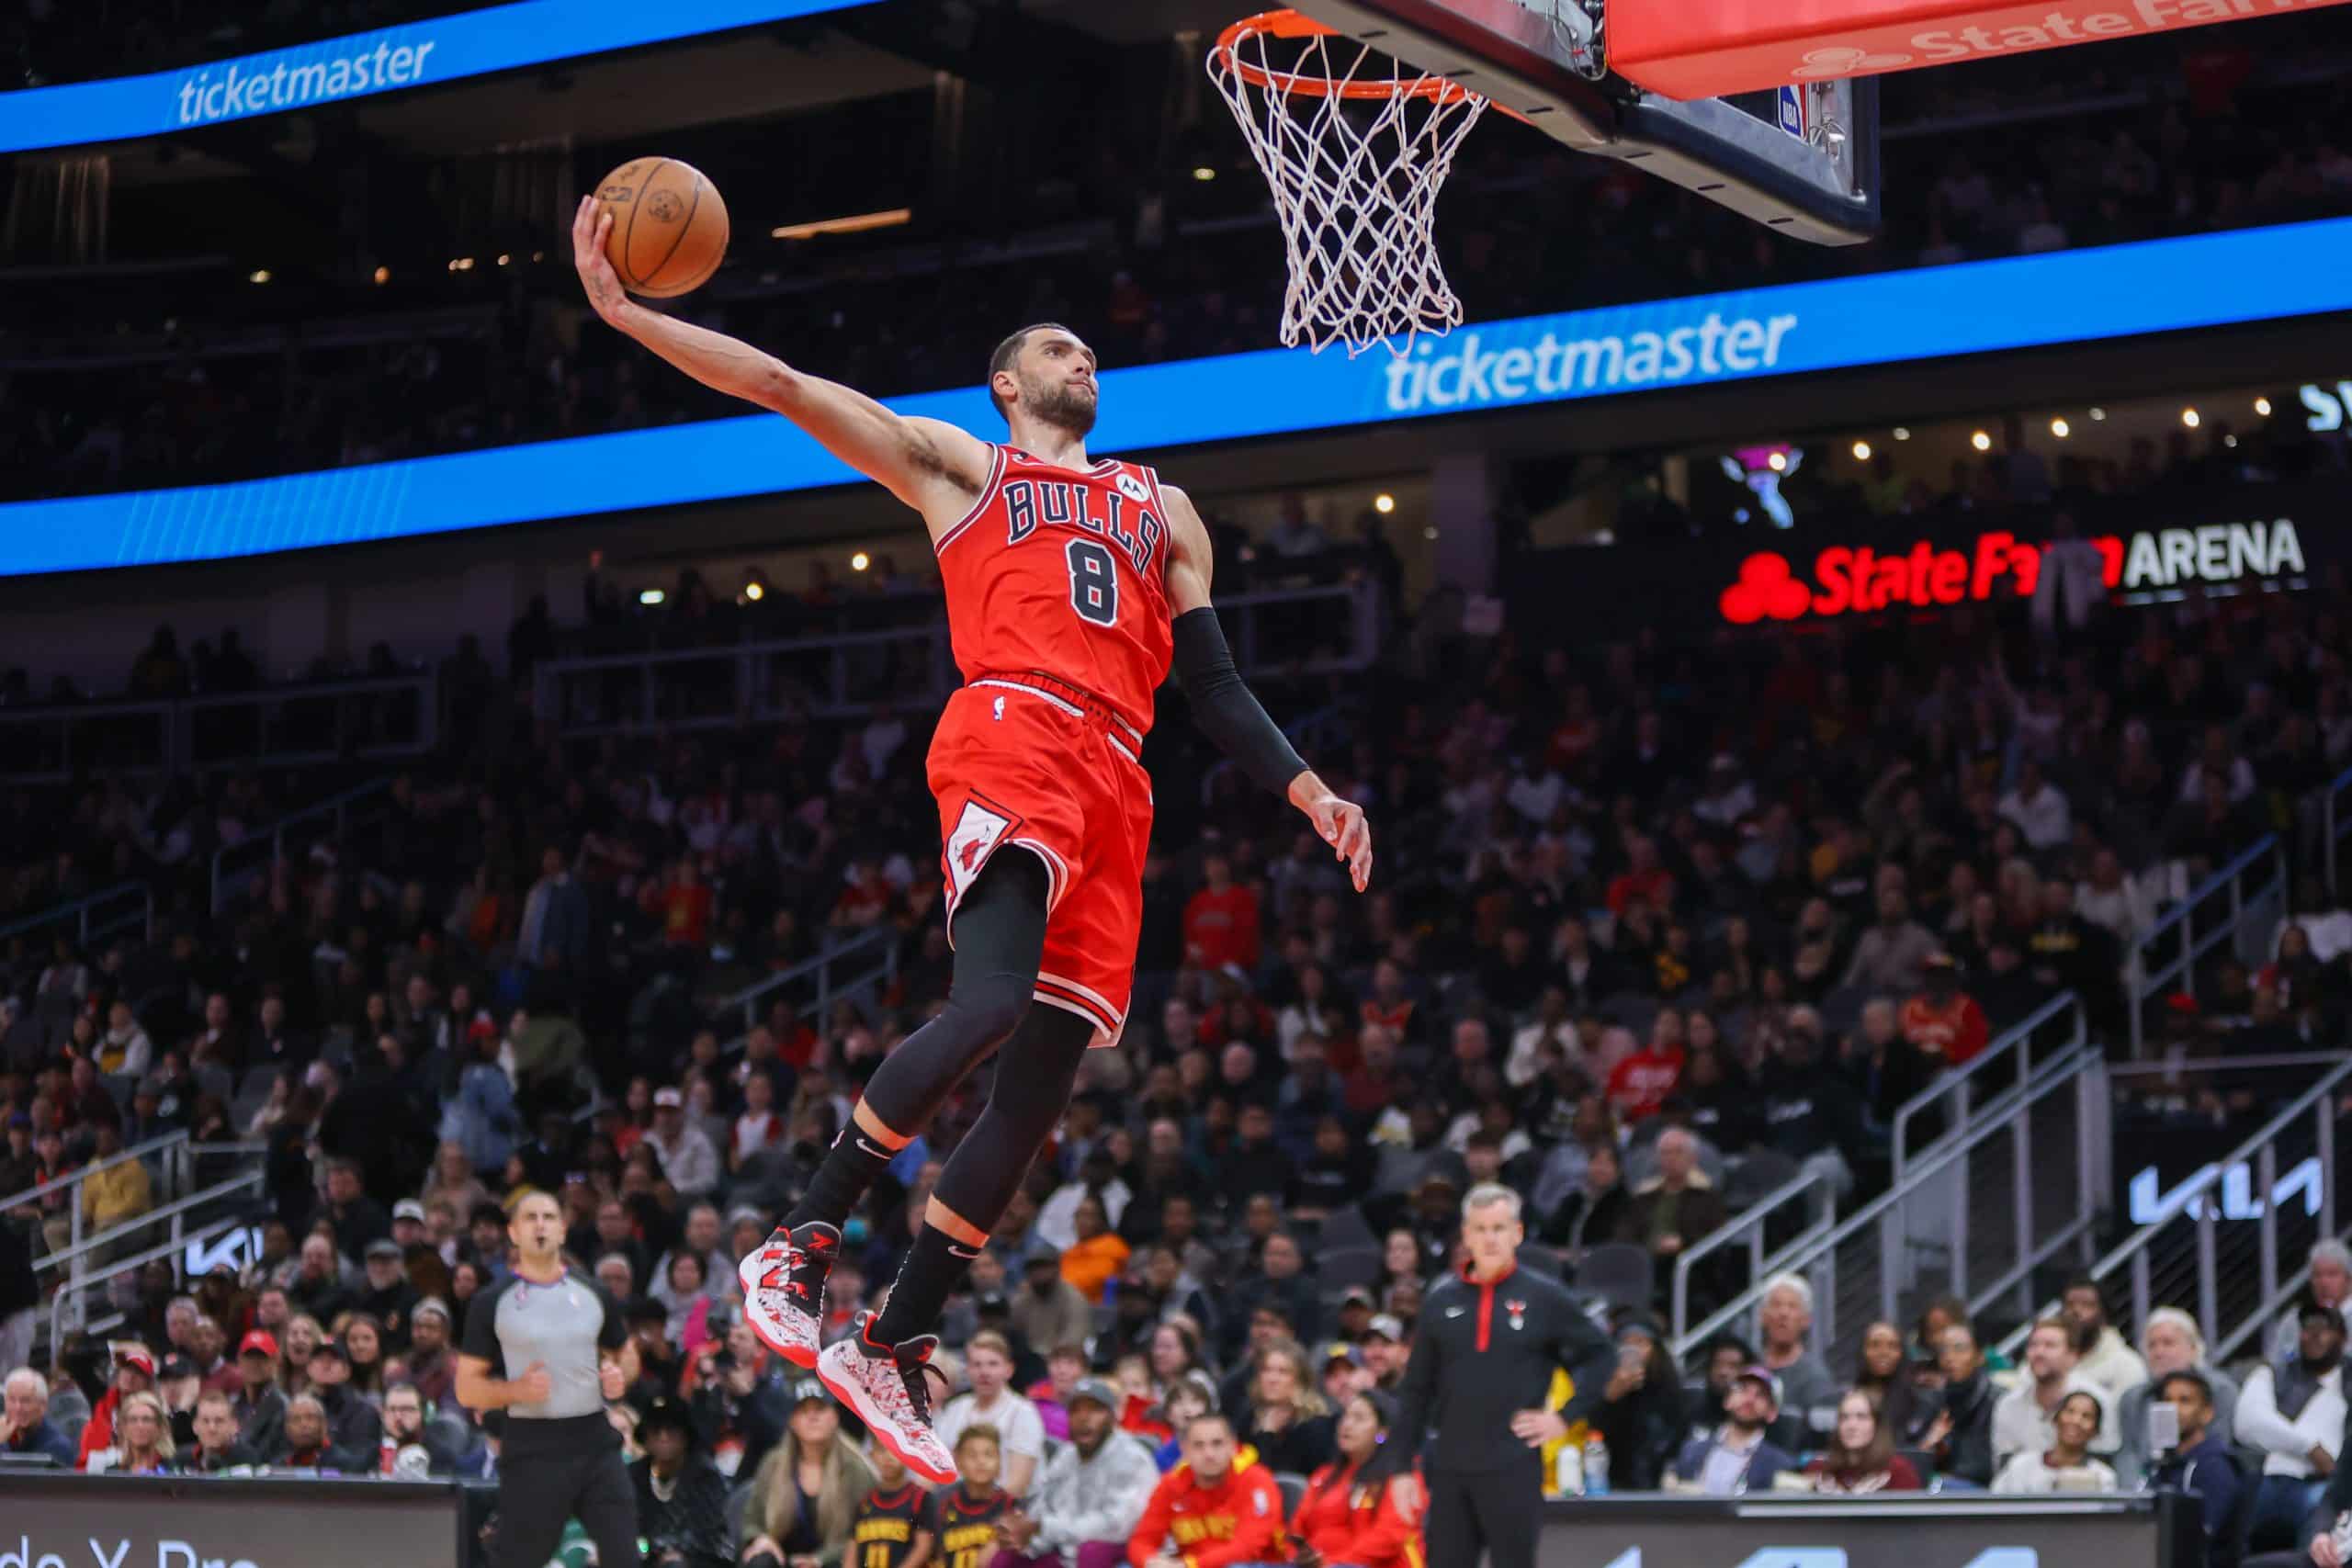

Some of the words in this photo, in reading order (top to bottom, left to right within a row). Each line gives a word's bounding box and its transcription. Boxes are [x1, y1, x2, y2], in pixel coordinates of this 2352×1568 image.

[1910, 8, 2132, 59] State
[178, 39, 435, 124] ticketmaster
[1782, 100, 1798, 130] NBA
[1385, 312, 1798, 412] ticketmaster
[1004, 479, 1160, 580] BULLS
[1813, 540, 1969, 616] State
[2124, 518, 2306, 589] ARENA
[1065, 536, 1119, 628] 8
